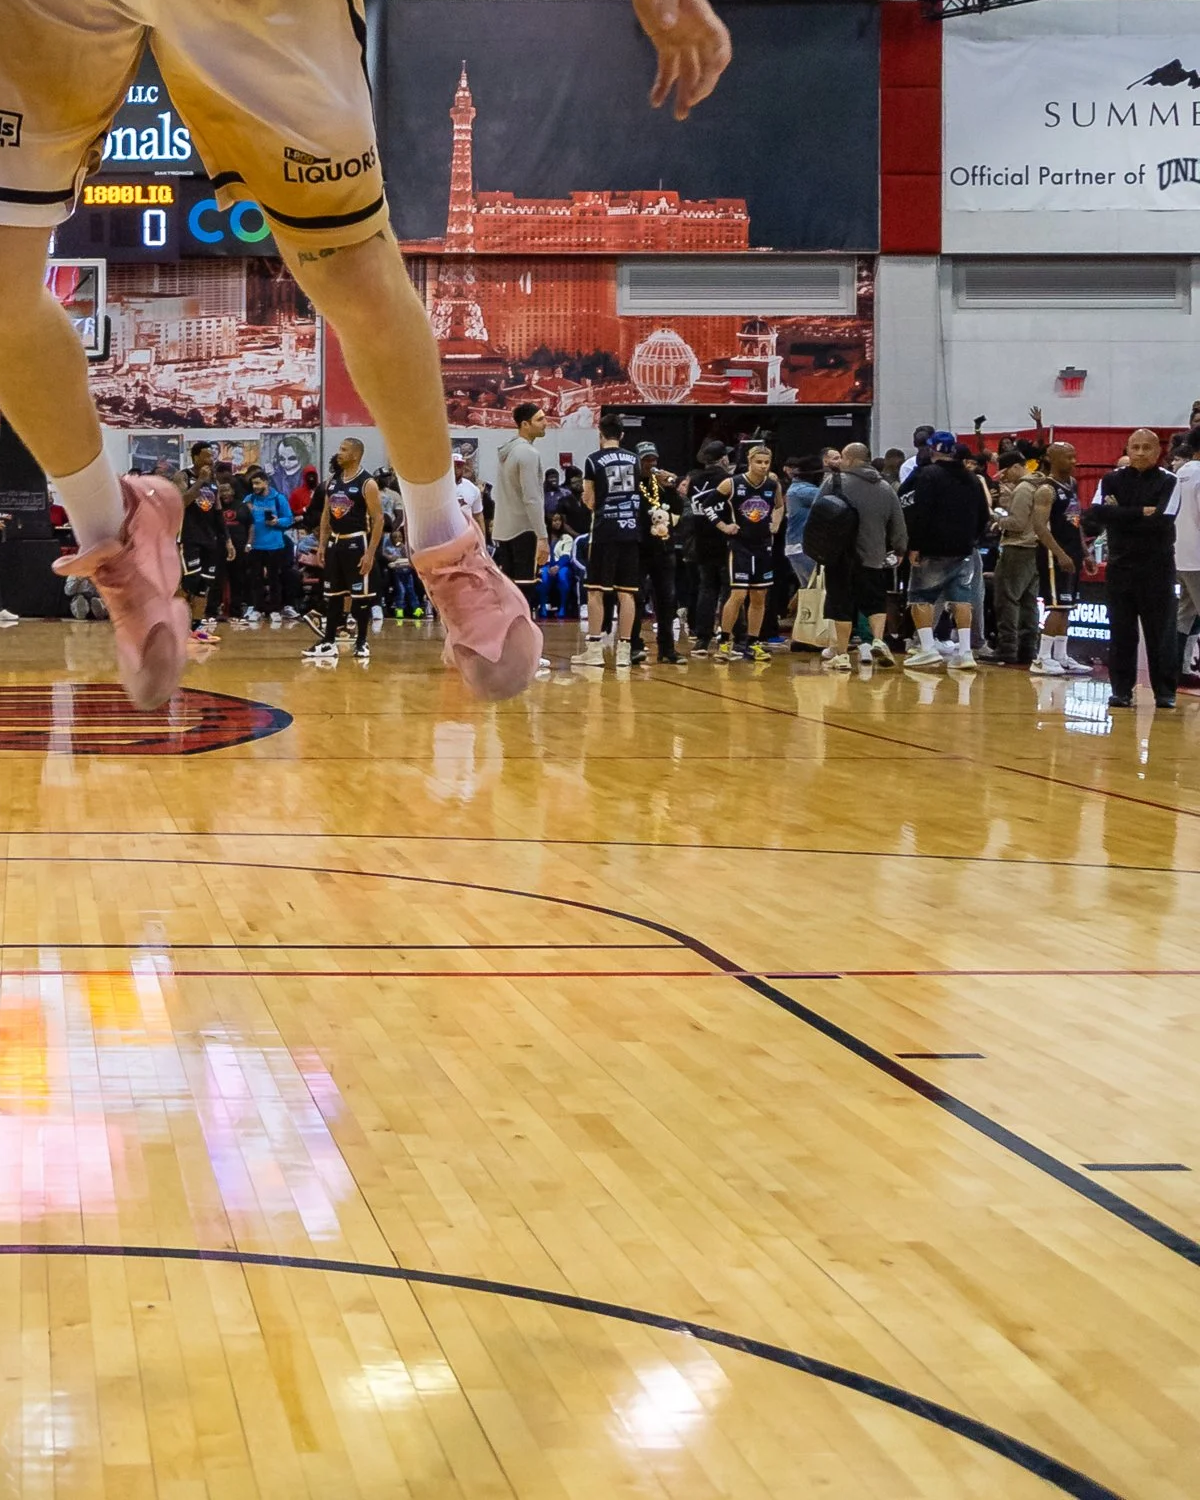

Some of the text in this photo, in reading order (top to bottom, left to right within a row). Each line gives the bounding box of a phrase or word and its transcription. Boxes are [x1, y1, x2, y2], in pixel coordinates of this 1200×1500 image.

[283, 145, 376, 183] LIQUORS
[950, 164, 1029, 186] Official
[1039, 166, 1116, 186] Partner
[1124, 164, 1146, 185] of
[143, 209, 166, 246] 0
[188, 198, 272, 244] CO
[605, 465, 635, 493] 26
